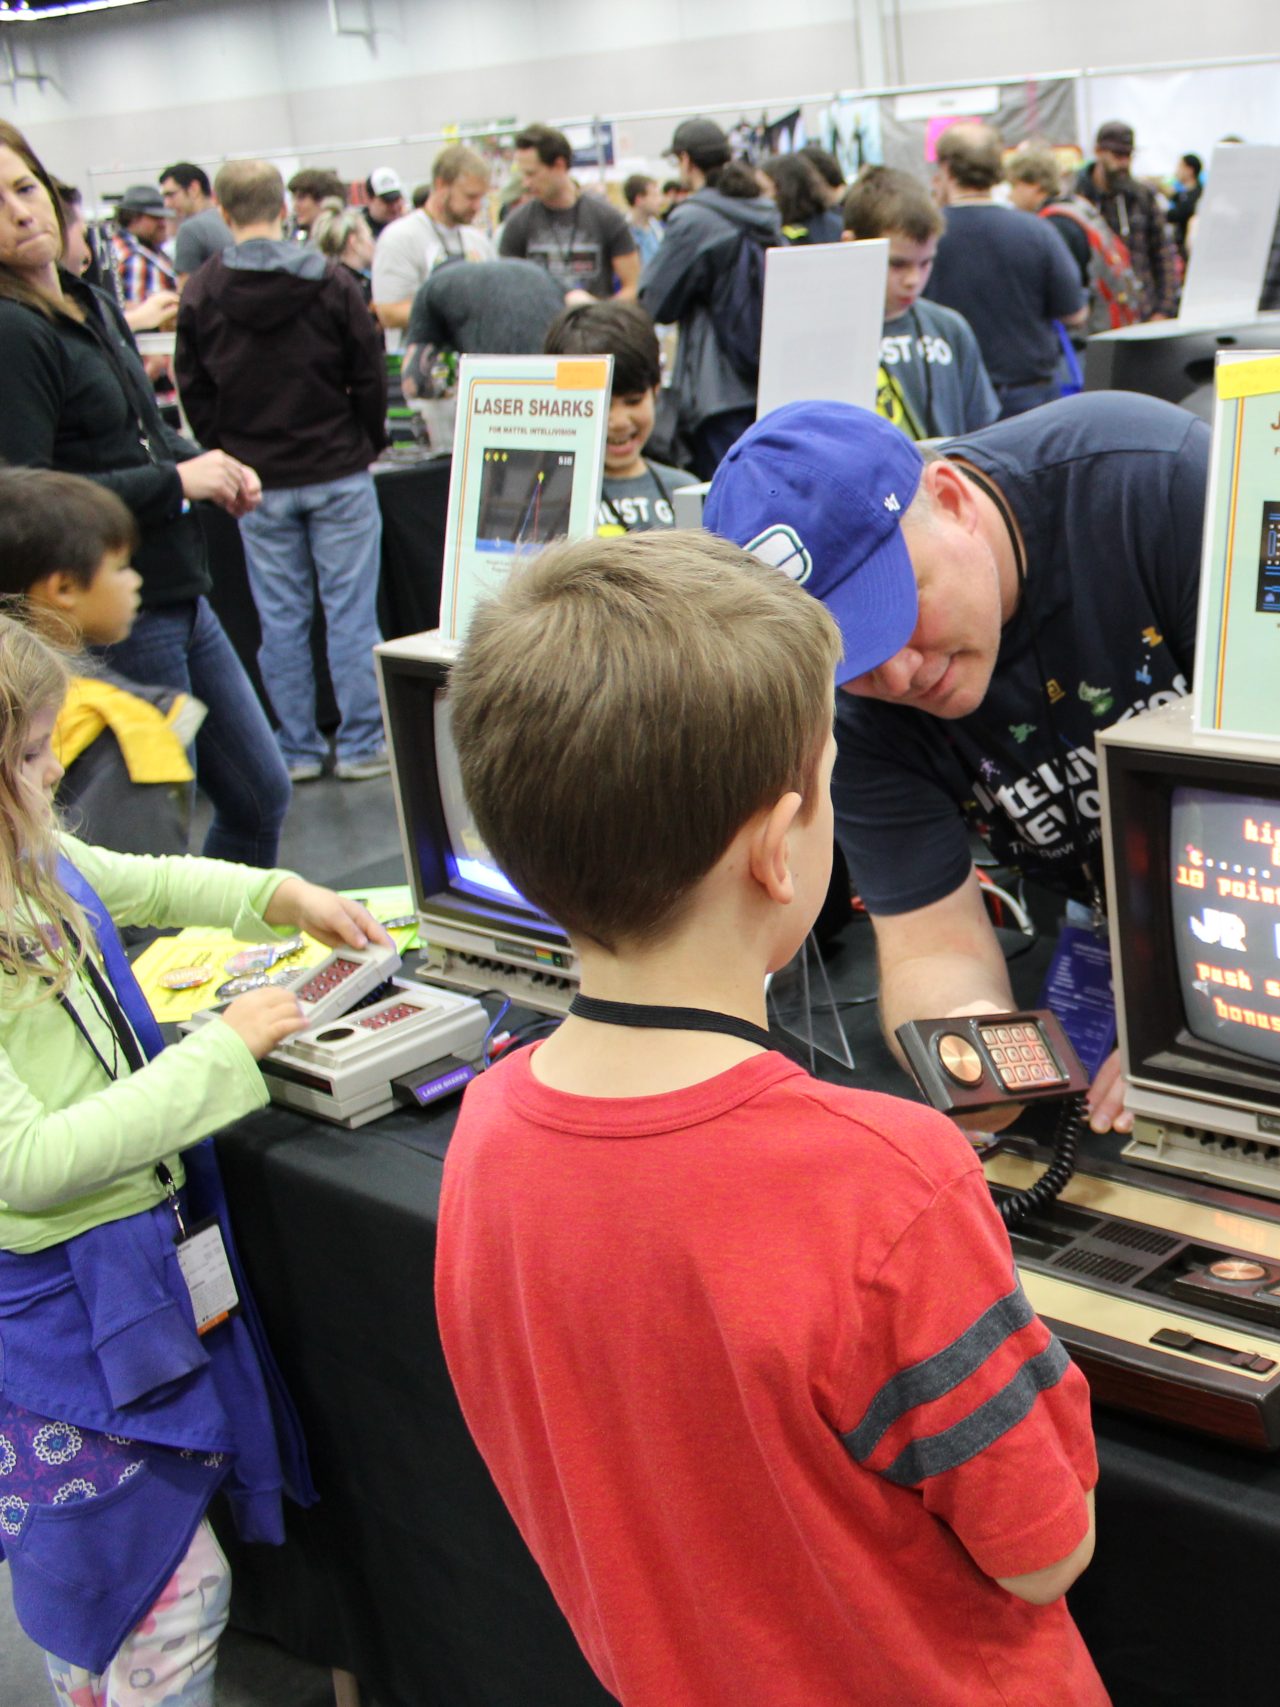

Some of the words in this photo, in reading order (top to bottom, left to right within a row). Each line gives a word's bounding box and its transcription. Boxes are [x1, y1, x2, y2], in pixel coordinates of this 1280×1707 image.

[879, 334, 912, 365] ST
[474, 398, 523, 416] LASER
[529, 399, 594, 418] SHARKS
[489, 426, 501, 434] FOR
[503, 427, 528, 435] MATTEL
[530, 428, 577, 436] INTELLIVISION
[599, 497, 649, 525] UST
[1176, 865, 1205, 889] 10
[1190, 908, 1248, 952] JR
[1195, 962, 1252, 991] push
